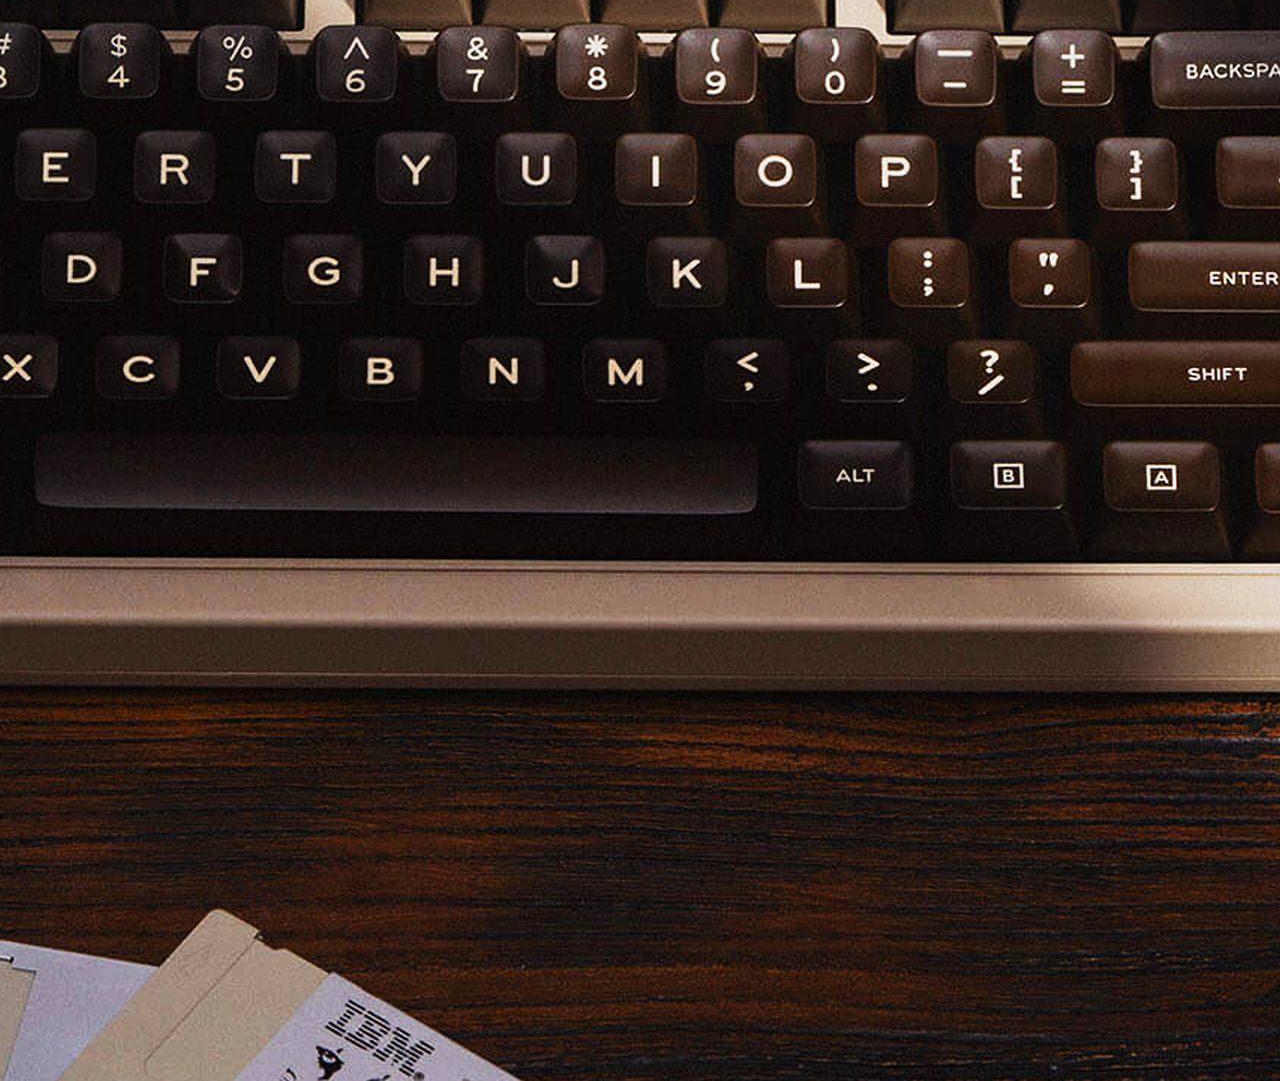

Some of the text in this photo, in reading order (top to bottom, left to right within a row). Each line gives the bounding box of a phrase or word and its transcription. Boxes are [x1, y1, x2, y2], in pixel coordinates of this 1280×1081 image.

[110, 33, 127, 58] $
[222, 35, 253, 62] %
[466, 36, 488, 61] &
[107, 65, 130, 88] 4
[225, 68, 245, 92] 5
[345, 69, 366, 93] 6
[465, 68, 485, 93] 7
[587, 66, 608, 91] 8
[705, 70, 727, 95] 9
[824, 70, 846, 95] 0
[42, 151, 69, 183] E
[160, 153, 189, 185] R
[279, 153, 312, 185] T
[401, 154, 431, 186] Y
[521, 155, 551, 186] U
[652, 155, 660, 187] I
[757, 155, 793, 187] O
[881, 156, 911, 188] P
[66, 254, 97, 284] D
[190, 257, 217, 287] F
[307, 256, 340, 286] G
[429, 257, 459, 287] H
[552, 259, 579, 289] J
[672, 259, 702, 289] K
[794, 259, 821, 290] L
[1209, 270, 1279, 286] ENTER
[2, 354, 33, 382] X
[122, 355, 155, 383] C
[243, 356, 277, 383] V
[366, 357, 395, 385] B
[488, 357, 519, 385] N
[607, 358, 643, 386] M
[980, 349, 1000, 374] ?
[1187, 367, 1248, 381] SHIFT
[835, 468, 875, 483] ALT
[324, 998, 436, 1078] IBM
